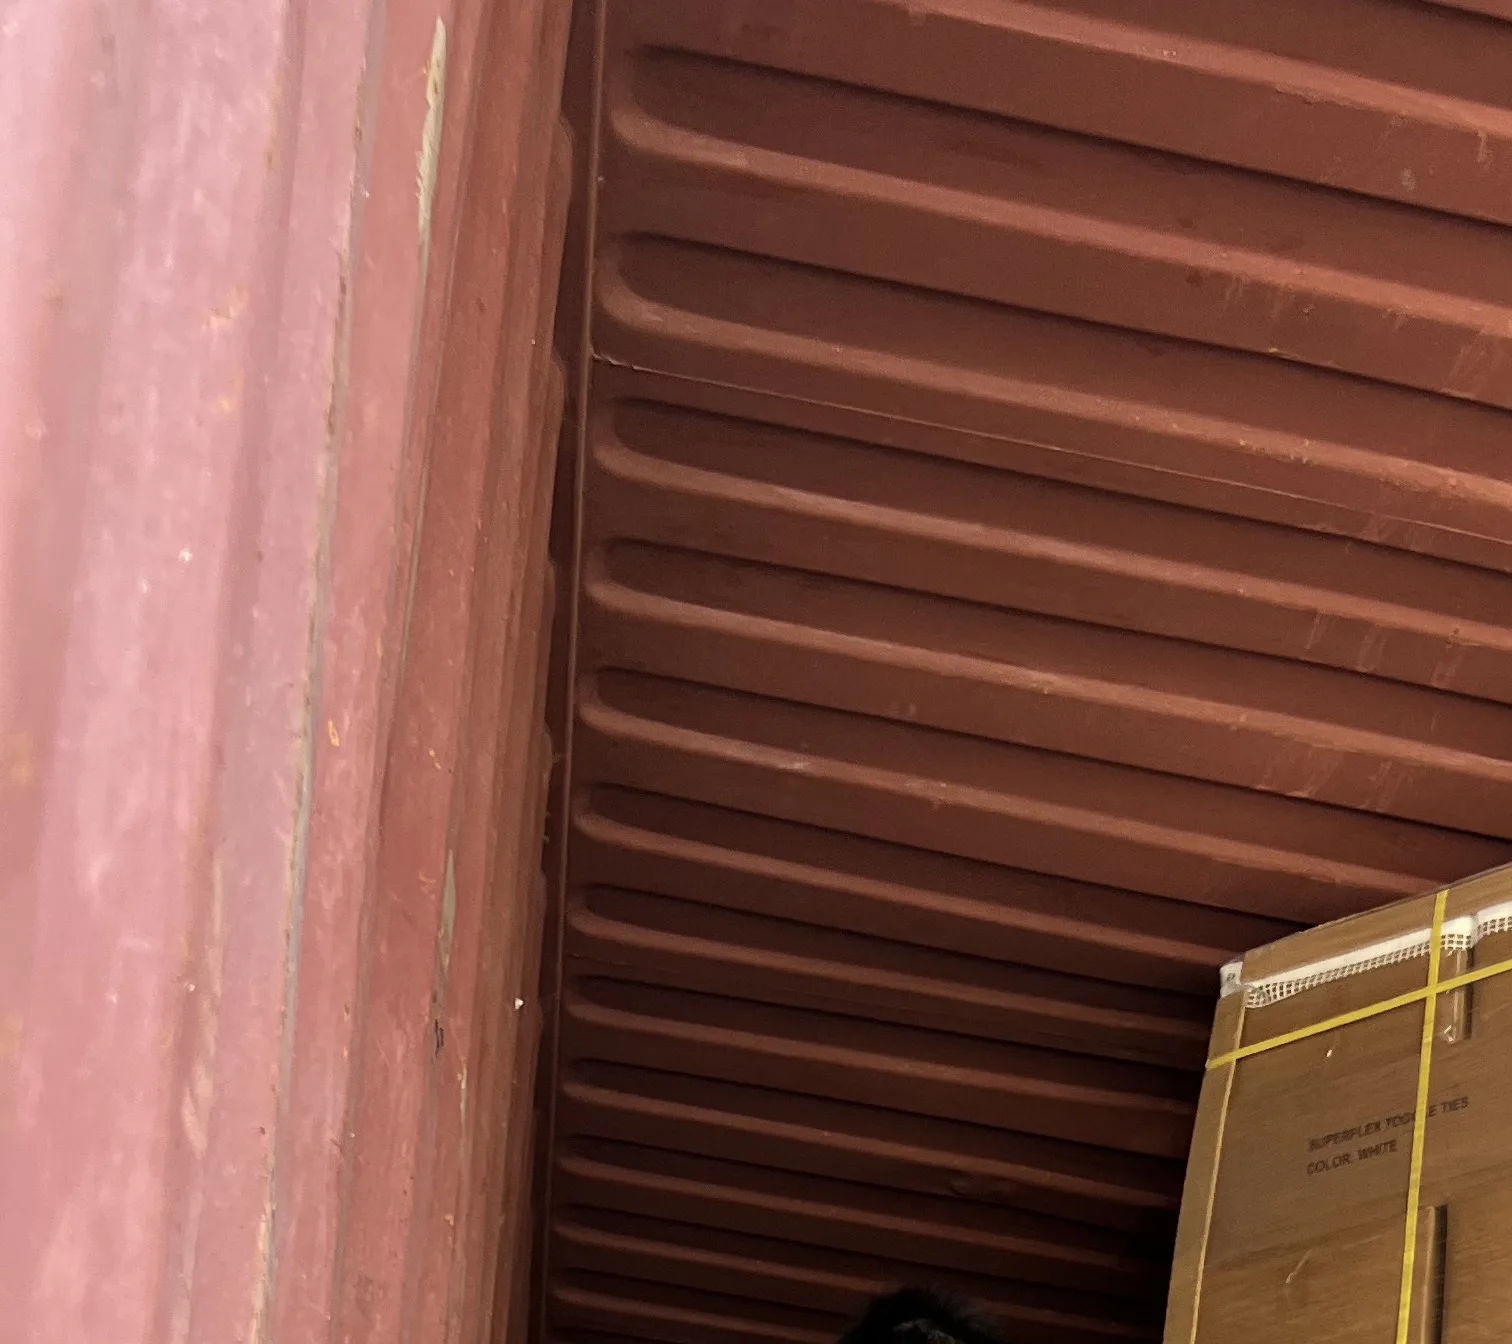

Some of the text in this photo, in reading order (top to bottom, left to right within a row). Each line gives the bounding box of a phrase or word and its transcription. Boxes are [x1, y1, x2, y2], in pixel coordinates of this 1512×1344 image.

[1308, 1121, 1381, 1151] SUPERFLEX
[1441, 1096, 1470, 1113] TIES
[1357, 1139, 1397, 1160] WHITE
